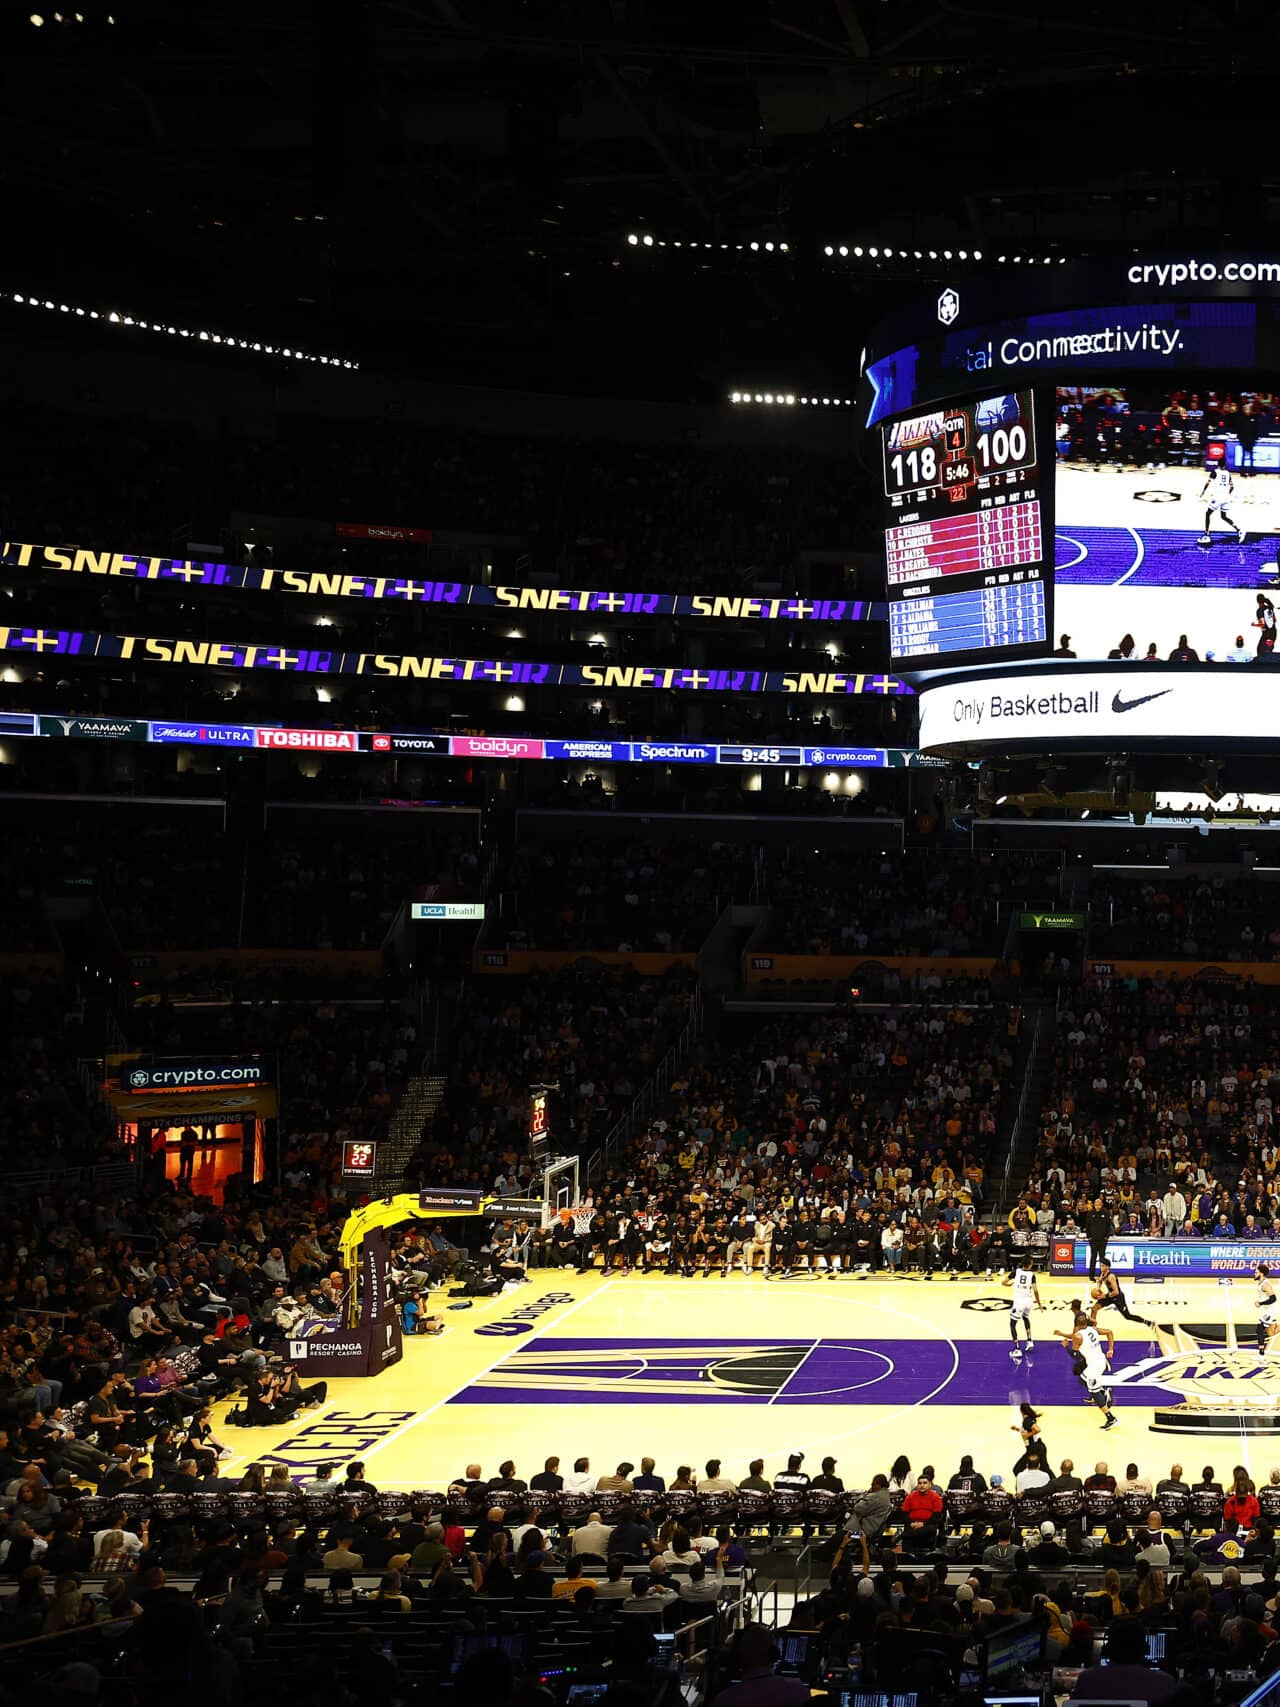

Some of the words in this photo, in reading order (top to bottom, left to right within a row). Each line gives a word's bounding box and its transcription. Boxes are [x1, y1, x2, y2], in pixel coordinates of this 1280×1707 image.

[946, 417, 964, 432] QTR
[951, 431, 961, 448] 4
[890, 447, 937, 487] 118
[976, 425, 1027, 468] 100
[946, 464, 969, 481] 5:46
[952, 488, 964, 500] 22
[953, 699, 985, 724] Only
[990, 691, 1099, 718] Basketball
[208, 731, 250, 742] ULTRA
[260, 731, 351, 748] TOSHIBA
[393, 739, 435, 749] TOYOTA
[468, 739, 528, 755] boldyn
[562, 743, 612, 751] AMERICAN
[569, 751, 612, 759] EXPRESS
[640, 745, 705, 760] Spectrum
[742, 750, 780, 762] 9:45
[826, 752, 877, 762] crypto.com
[423, 907, 444, 915] UCLA
[152, 1067, 260, 1084] crypto.com
[173, 1114, 241, 1128] CHAMPIONS
[533, 1110, 544, 1131] 22
[351, 1153, 367, 1166] 22
[1138, 1249, 1191, 1266] Health
[1210, 1246, 1247, 1258] WHERE
[1019, 1275, 1028, 1285] 8
[501, 1291, 576, 1321] bibigo
[1086, 1331, 1097, 1343] 2
[310, 1343, 362, 1351] PECHANGA
